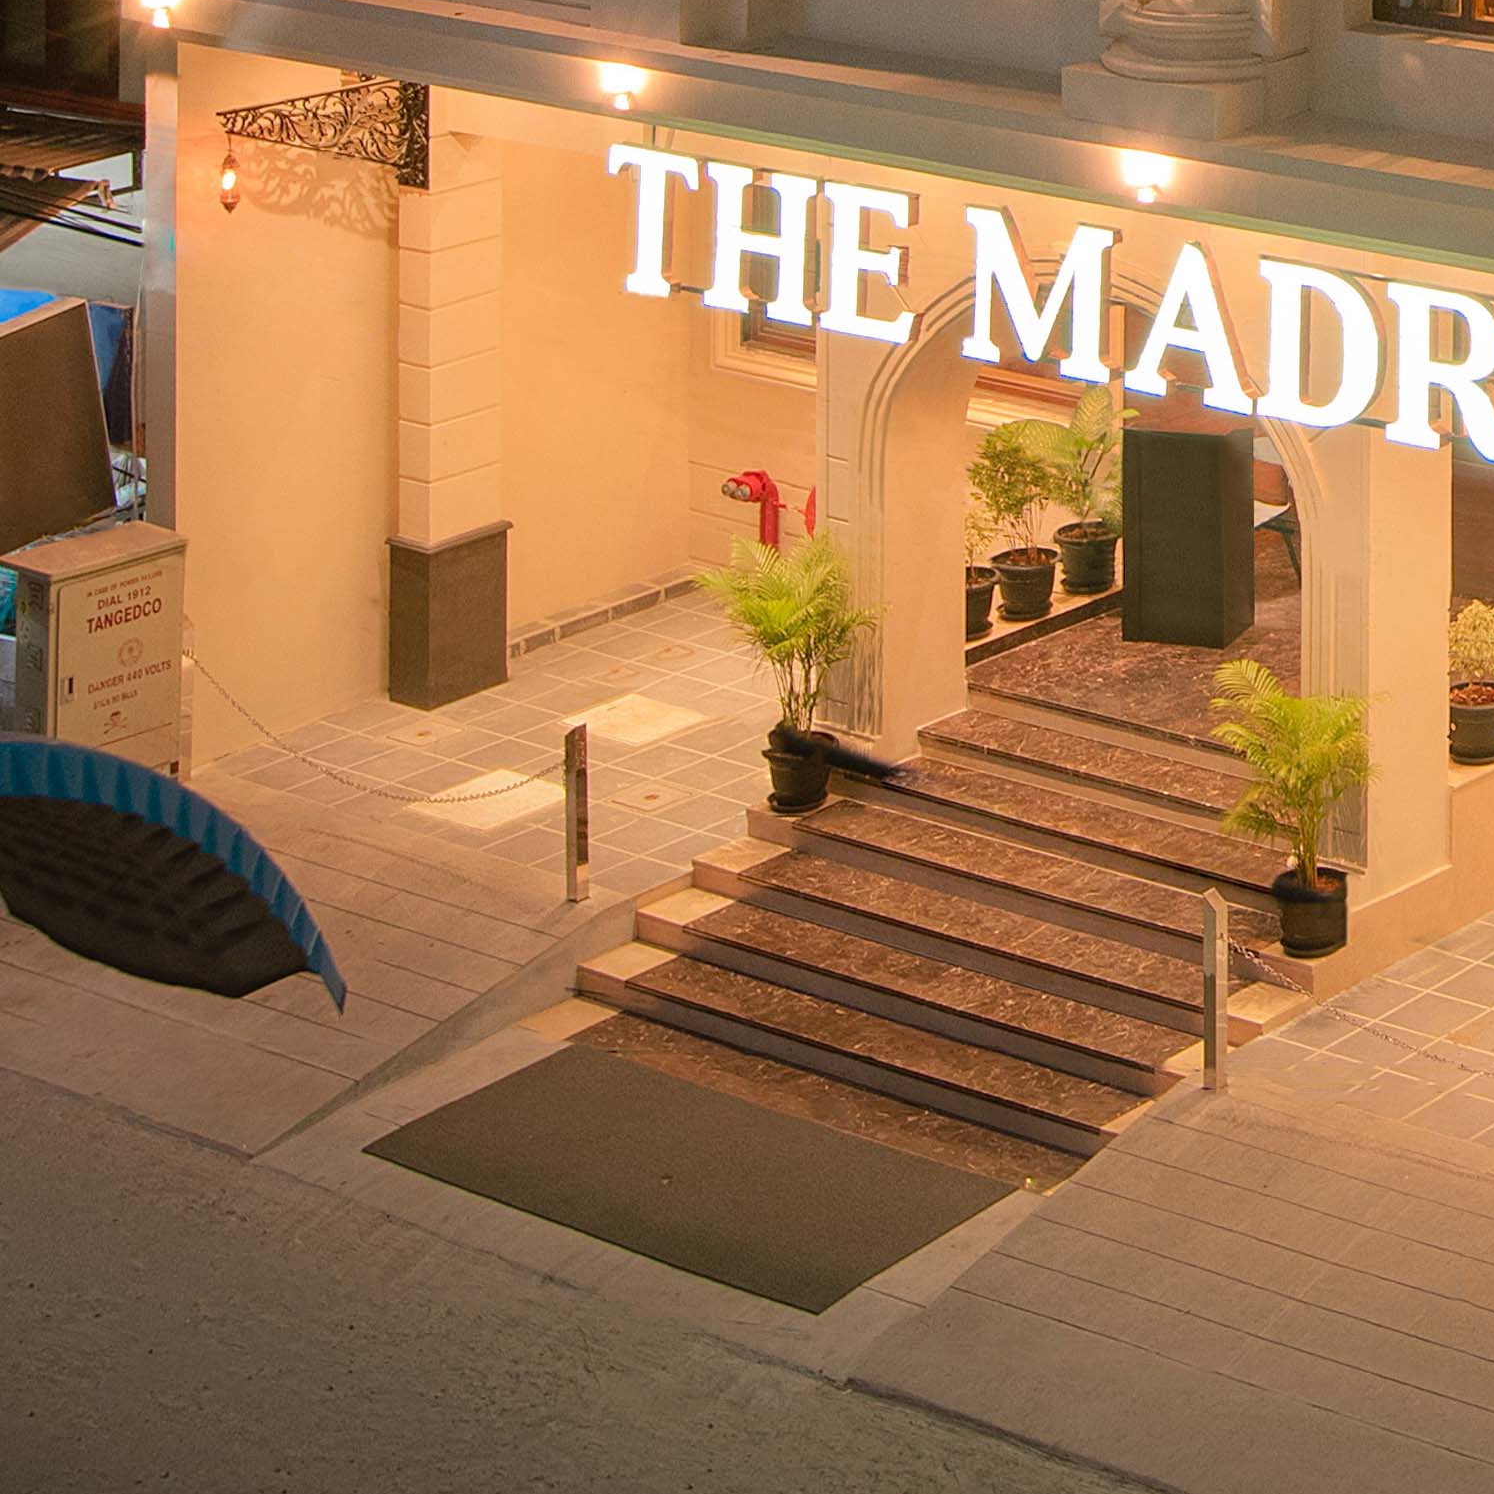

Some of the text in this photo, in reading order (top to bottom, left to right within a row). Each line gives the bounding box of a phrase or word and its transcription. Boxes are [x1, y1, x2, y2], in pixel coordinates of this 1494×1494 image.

[607, 142, 918, 346] THE
[86, 597, 163, 635] TANGEDCO
[97, 585, 152, 611] DIAL 1912
[87, 674, 125, 695] DANGER
[144, 659, 173, 676] VOLTS
